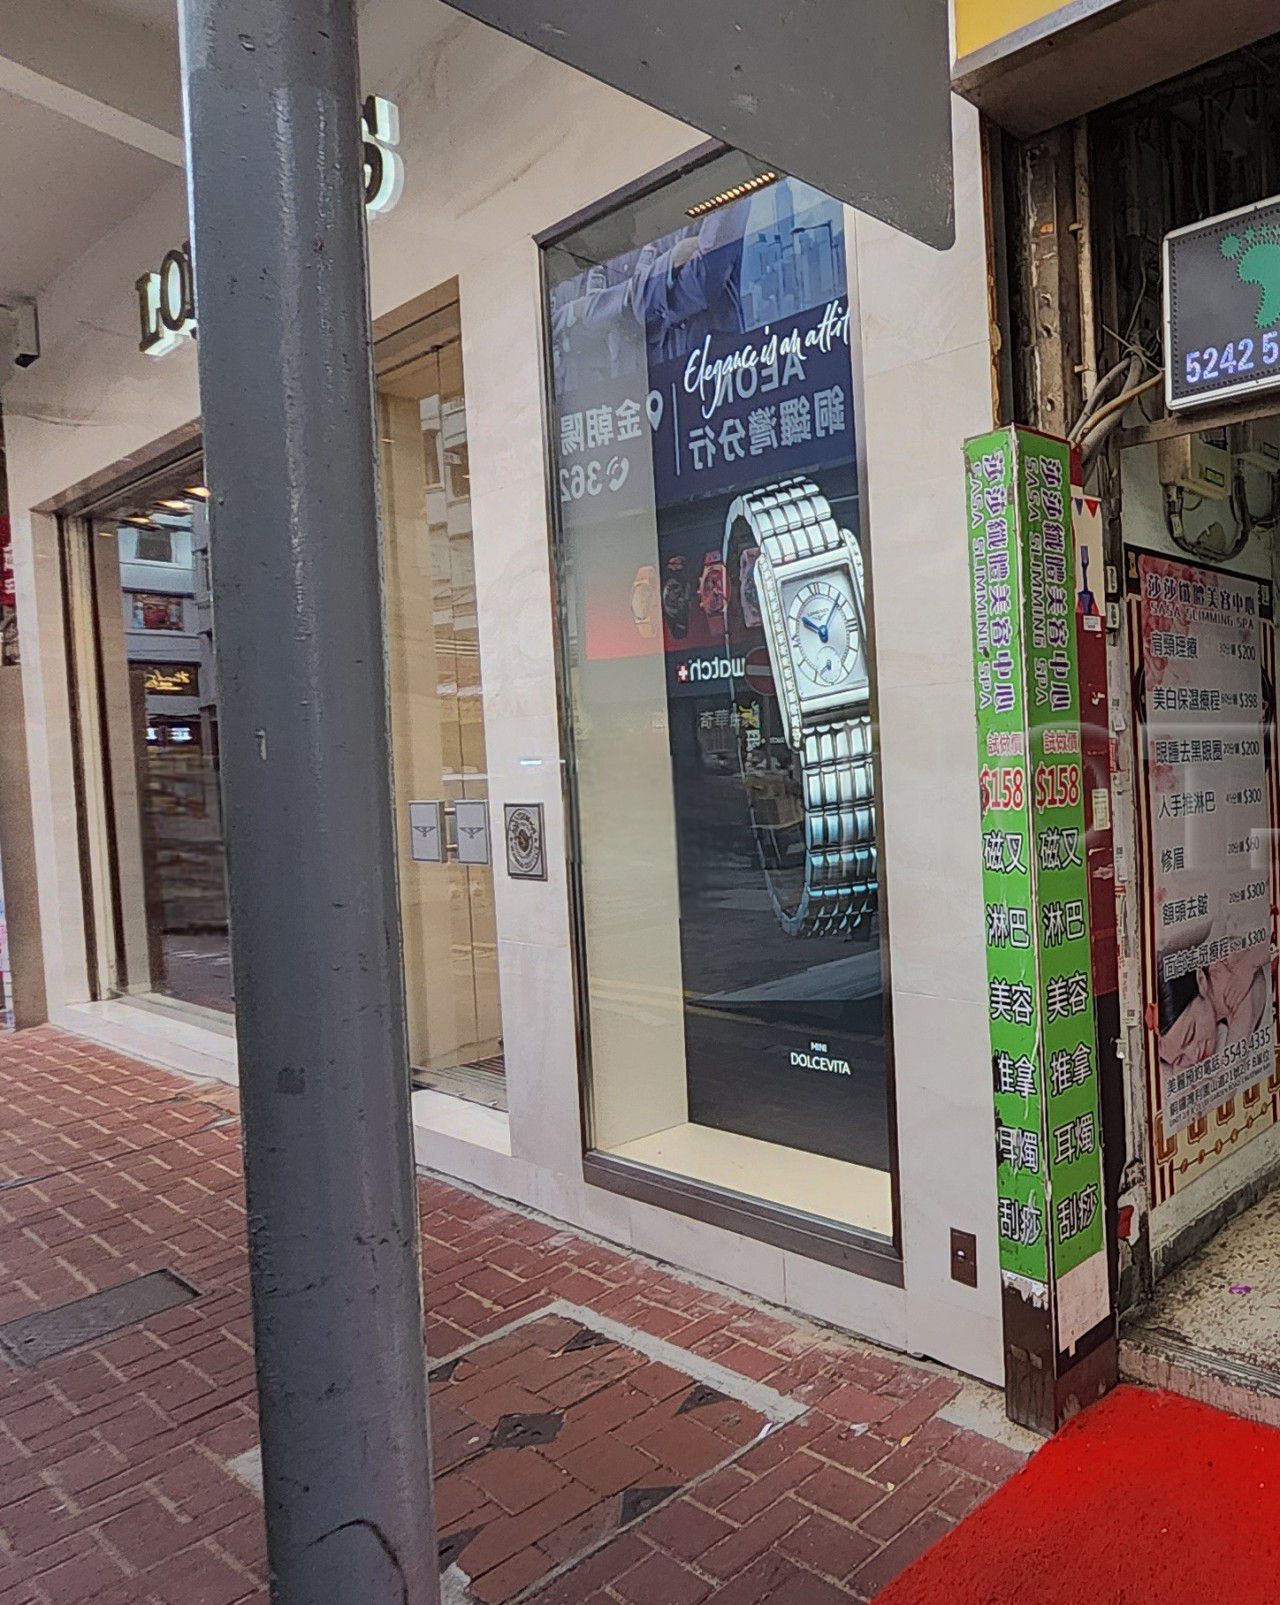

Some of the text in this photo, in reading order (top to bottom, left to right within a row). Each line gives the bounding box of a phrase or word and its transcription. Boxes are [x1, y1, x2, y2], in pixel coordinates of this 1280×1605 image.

[684, 334, 761, 420] Elegance
[1185, 337, 1255, 386] 5242
[983, 450, 1015, 714] 莎莎纖體美容中心
[1024, 455, 1049, 706] SASA SLIMMING SPA
[1040, 455, 1071, 712] 莎莎纖體美容中心
[1150, 602, 1255, 630] SASA SLIMMING SPA
[1237, 644, 1257, 661] $200
[978, 661, 992, 709] SPA
[1239, 691, 1258, 709] $398
[1042, 728, 1079, 755] 試做價
[1241, 740, 1260, 757] $200
[980, 763, 1024, 815] $158
[1035, 761, 1080, 815] $158
[1158, 790, 1216, 819] 人手推淋巴
[1243, 787, 1262, 805] $300
[1160, 846, 1185, 873] 修眉
[1246, 881, 1266, 900] $300
[985, 902, 1031, 948] 淋巴
[1042, 898, 1085, 947] 淋巴
[1248, 927, 1267, 947] $300
[989, 976, 1033, 1026] 美容
[1046, 971, 1089, 1024] 美容
[789, 1050, 852, 1077] DOLCEVITA
[1049, 1041, 1093, 1097] 推拿
[1223, 1038, 1248, 1067] 5543
[1249, 1026, 1271, 1051] 4335
[1052, 1111, 1095, 1167] 耳燭
[1055, 1183, 1099, 1245] 刮痧
